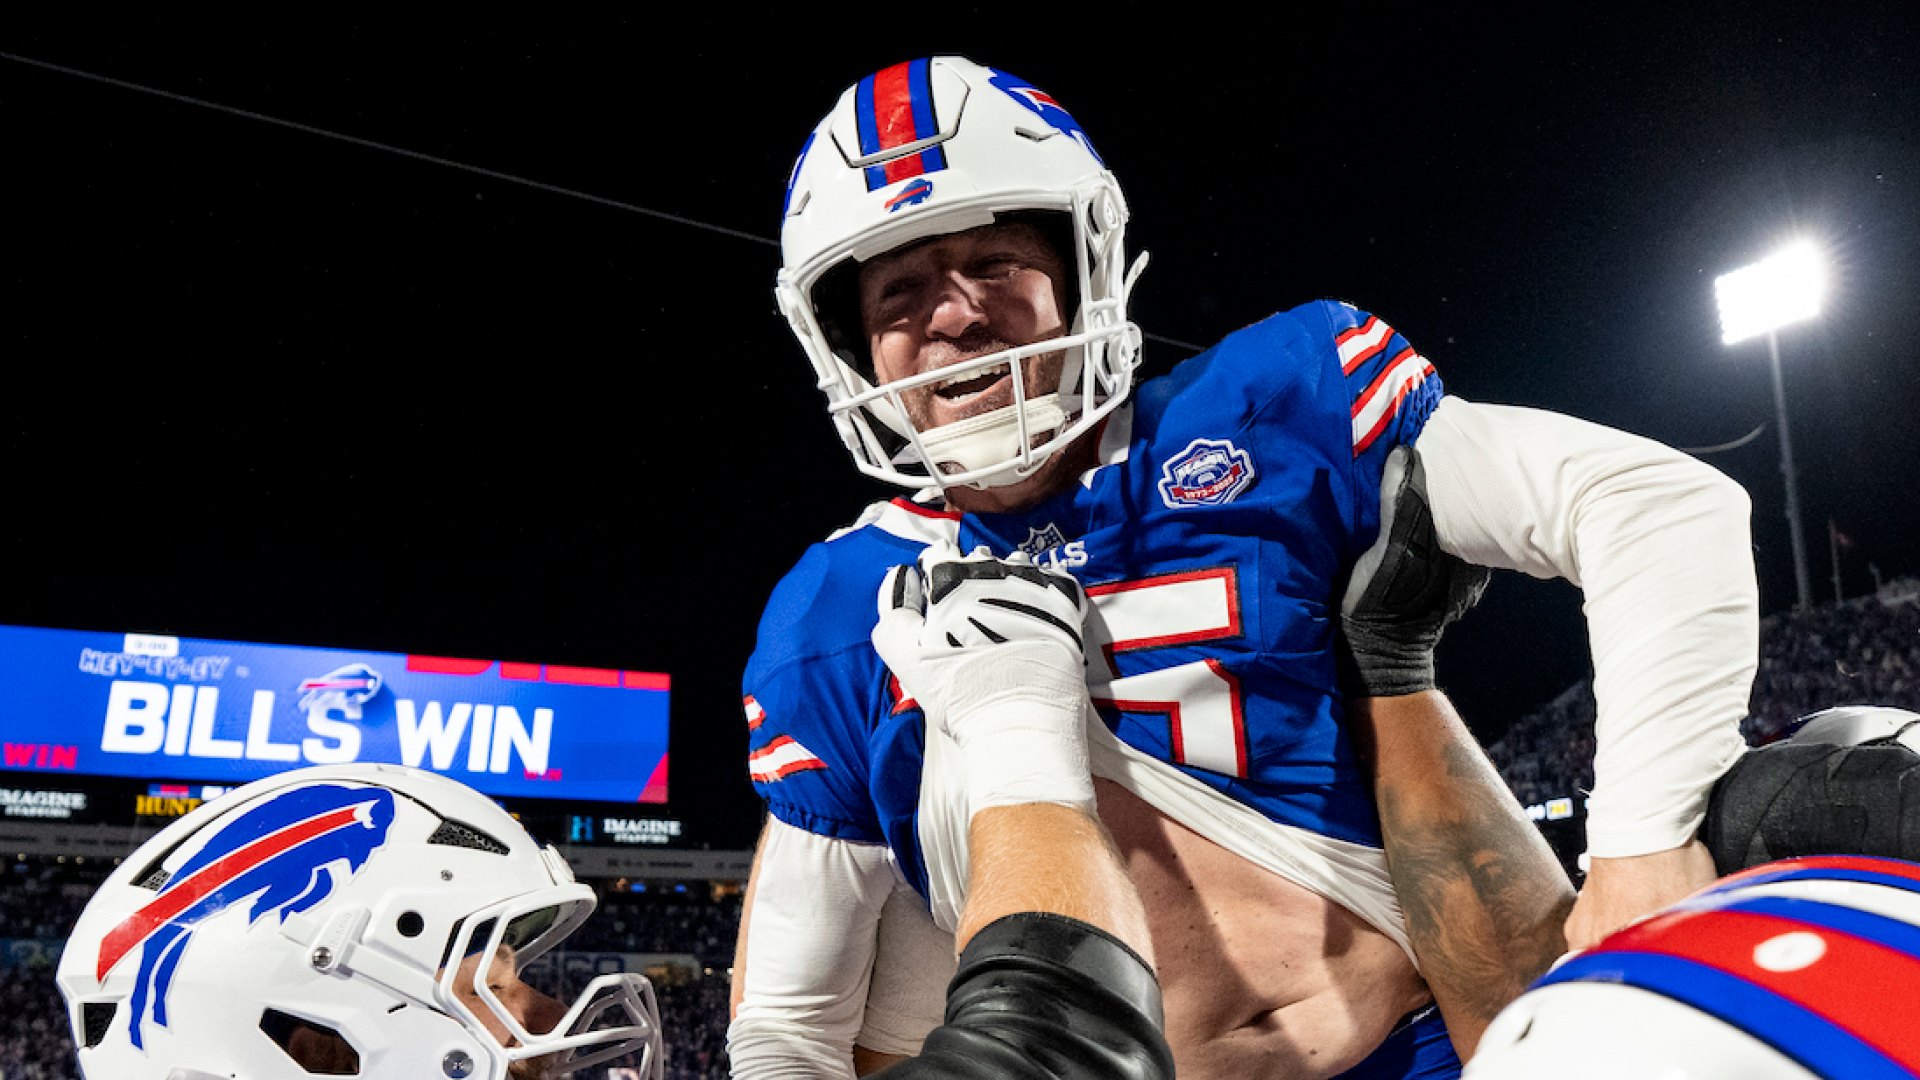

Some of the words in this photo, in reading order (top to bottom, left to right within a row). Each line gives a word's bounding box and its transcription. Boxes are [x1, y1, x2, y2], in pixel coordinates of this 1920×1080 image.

[1032, 540, 1090, 574] LLS
[101, 680, 363, 764] BILLS
[396, 699, 554, 775] WIN
[4, 742, 78, 769] WIN
[0, 789, 87, 809] MAGINE
[603, 818, 681, 836] IMAGINE
